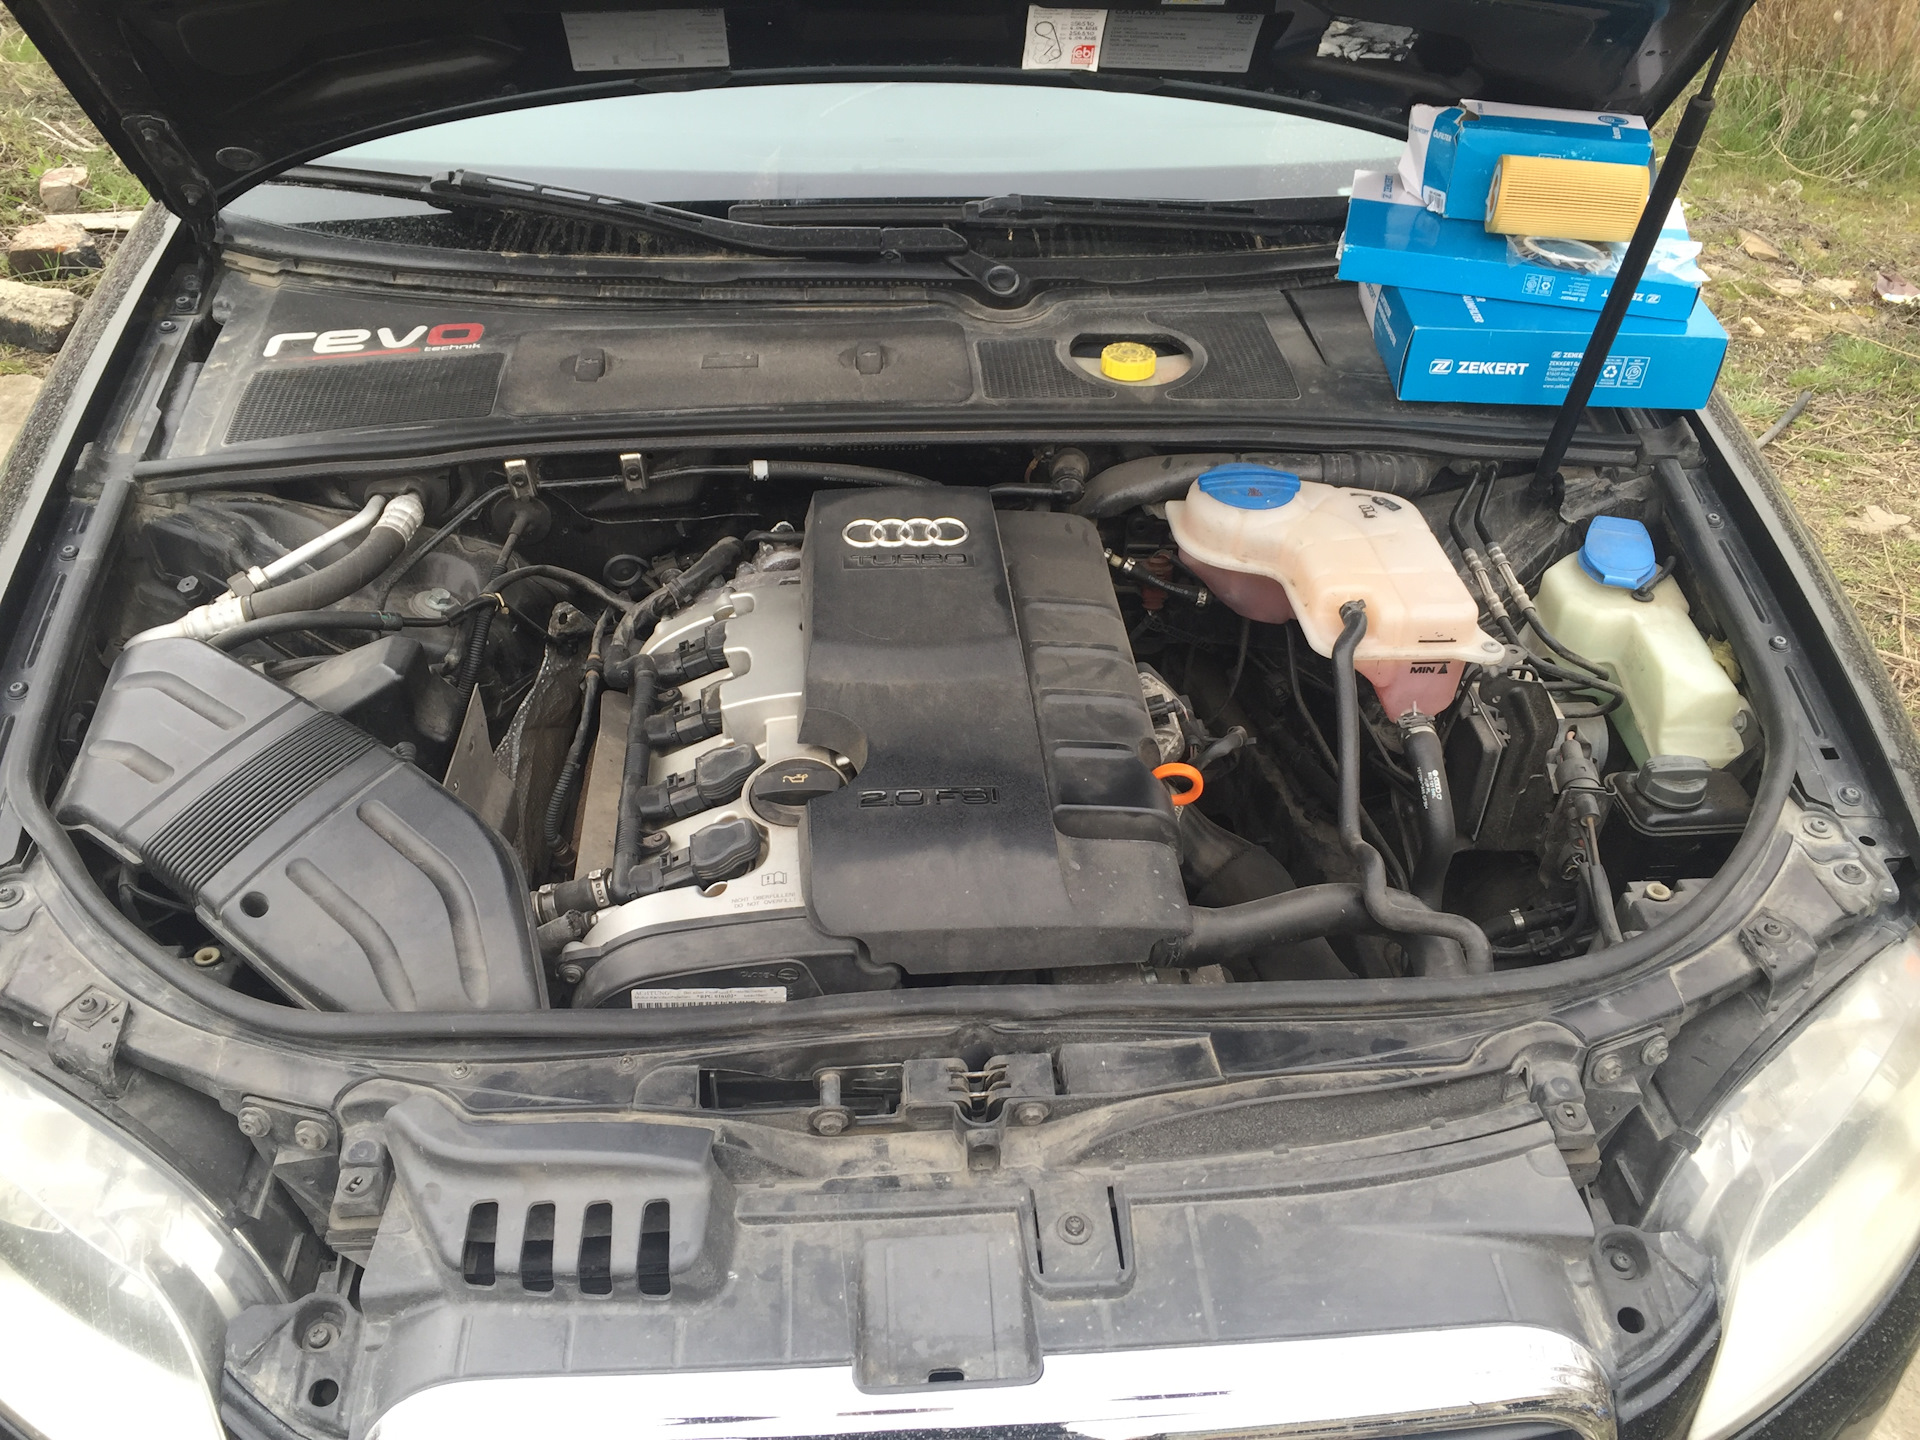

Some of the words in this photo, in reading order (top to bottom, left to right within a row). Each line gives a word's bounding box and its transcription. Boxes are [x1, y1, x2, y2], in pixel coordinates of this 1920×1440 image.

[263, 322, 485, 357] revo
[424, 342, 481, 352] technik
[1456, 361, 1530, 376] ZEKKERT
[850, 553, 968, 566] TURBO
[1410, 666, 1435, 674] MIN
[860, 789, 924, 808] 2.0
[935, 787, 998, 806] FSI
